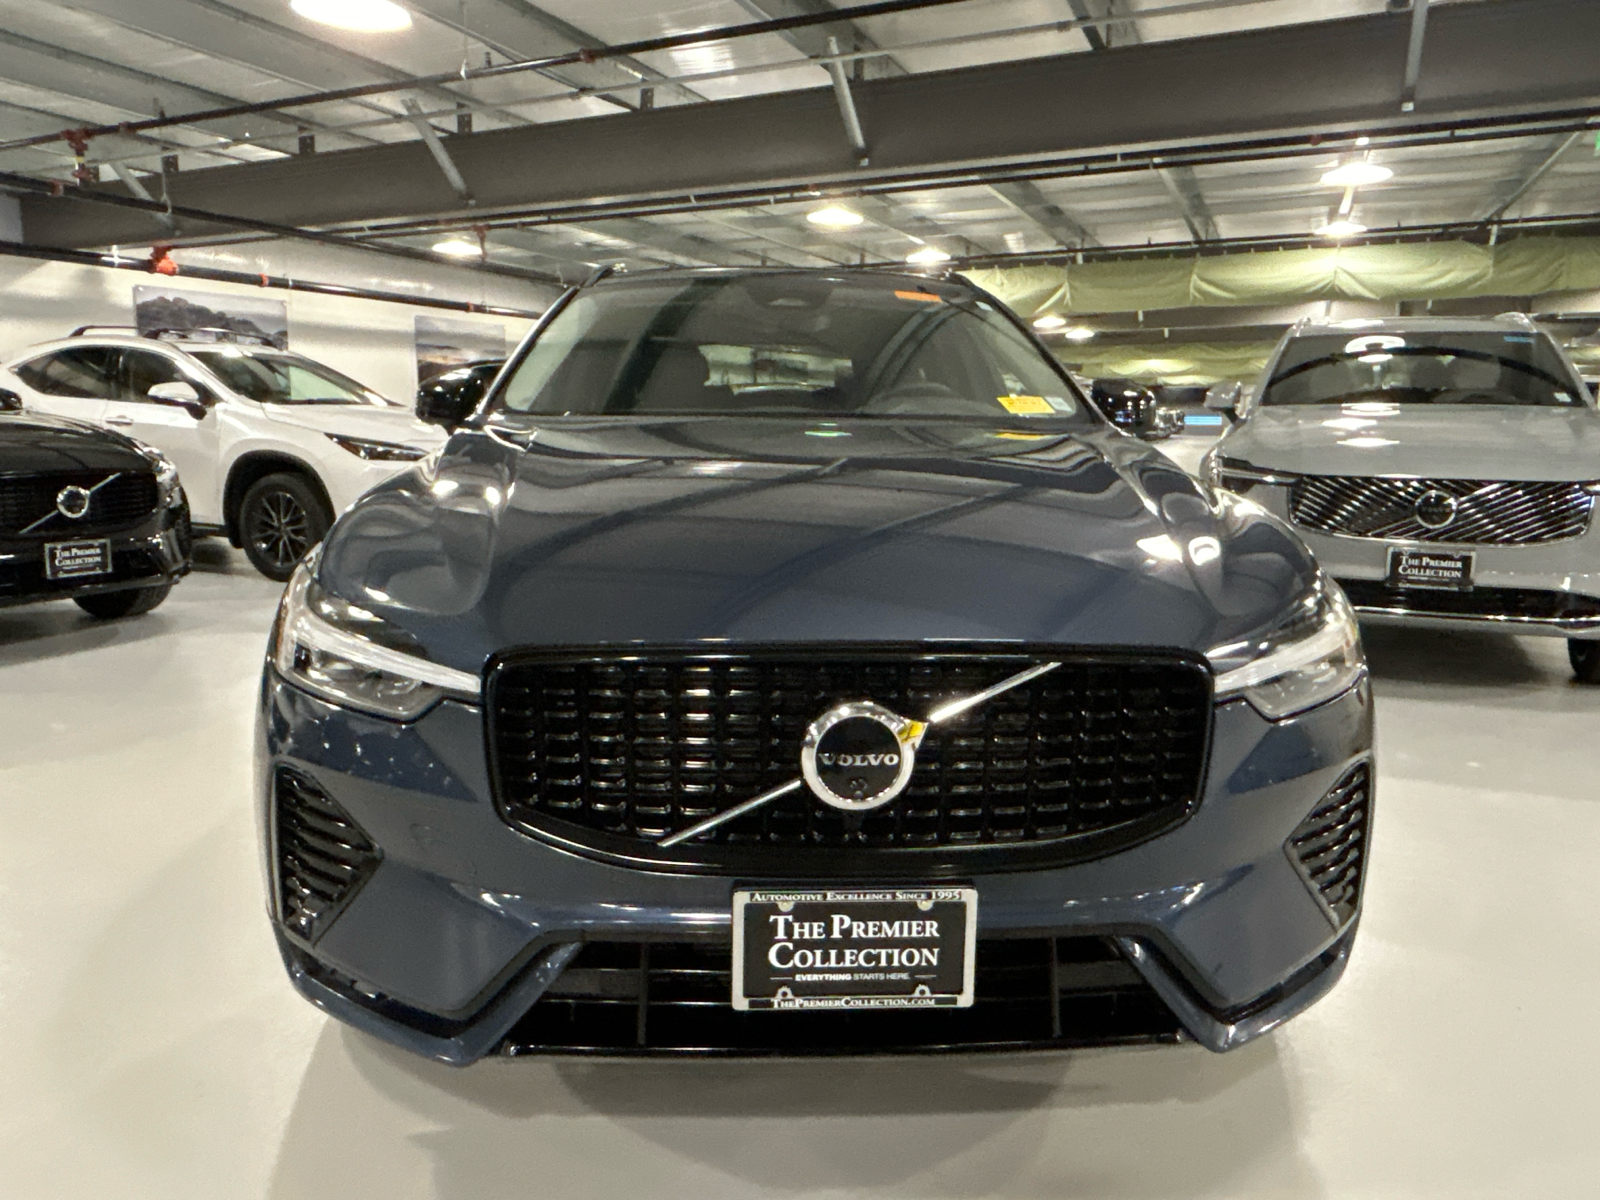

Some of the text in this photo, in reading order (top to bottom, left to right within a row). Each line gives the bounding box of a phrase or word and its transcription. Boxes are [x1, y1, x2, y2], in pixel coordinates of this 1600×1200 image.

[1400, 556, 1463, 568] THE PREMIER
[1398, 565, 1462, 577] COLLECTION
[818, 753, 899, 766] VOLVO
[752, 890, 961, 901] AUTOMOTIVE EXCELLENCE SINCE 1995
[769, 913, 941, 940] THE PREMIER
[768, 941, 939, 969] COLLECTION
[795, 973, 852, 982] EVERYTHING
[853, 972, 885, 981] STARTS
